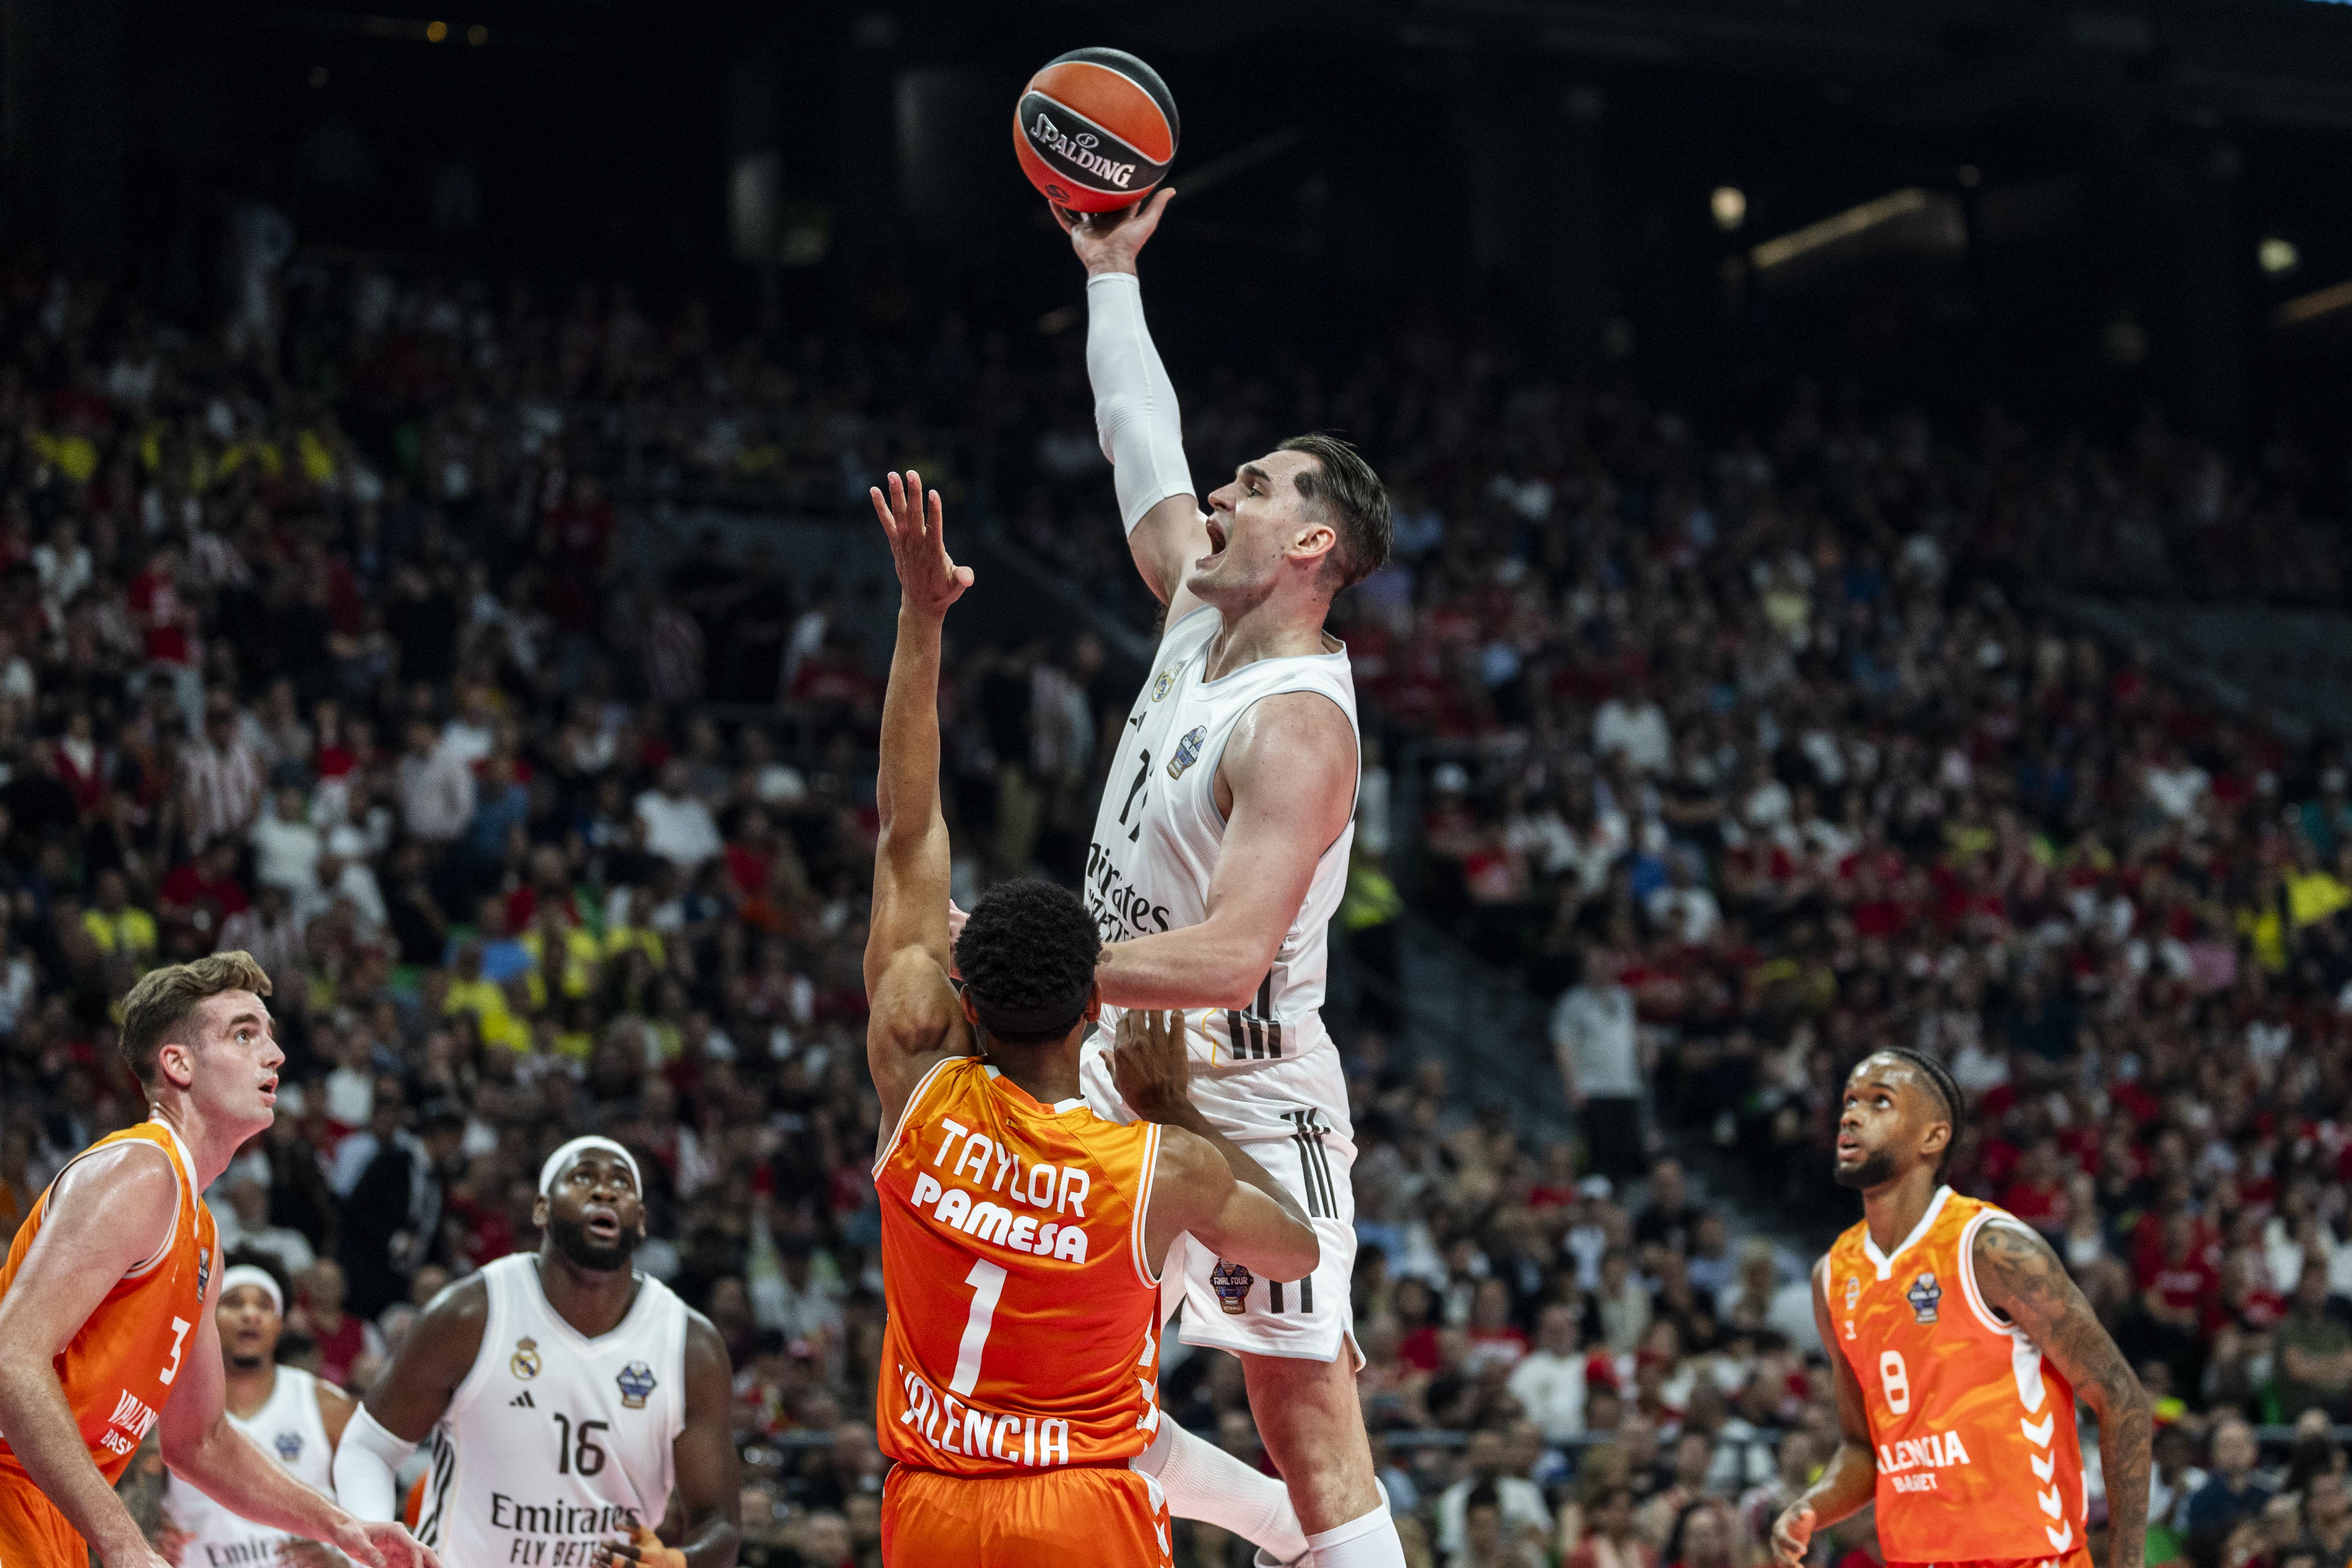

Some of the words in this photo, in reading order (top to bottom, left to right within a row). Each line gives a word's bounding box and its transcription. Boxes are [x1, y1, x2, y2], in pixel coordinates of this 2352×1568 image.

[1031, 113, 1136, 188] SPALDING
[933, 1118, 1090, 1217] TAYLOR
[910, 1171, 1088, 1264] PAMESA
[1231, 1276, 1248, 1285] FOUR
[159, 1315, 192, 1386] 3
[948, 1257, 1008, 1398] 1
[1880, 1350, 1910, 1414] 8
[554, 1412, 608, 1476] 16
[510, 1537, 546, 1566] FLY
